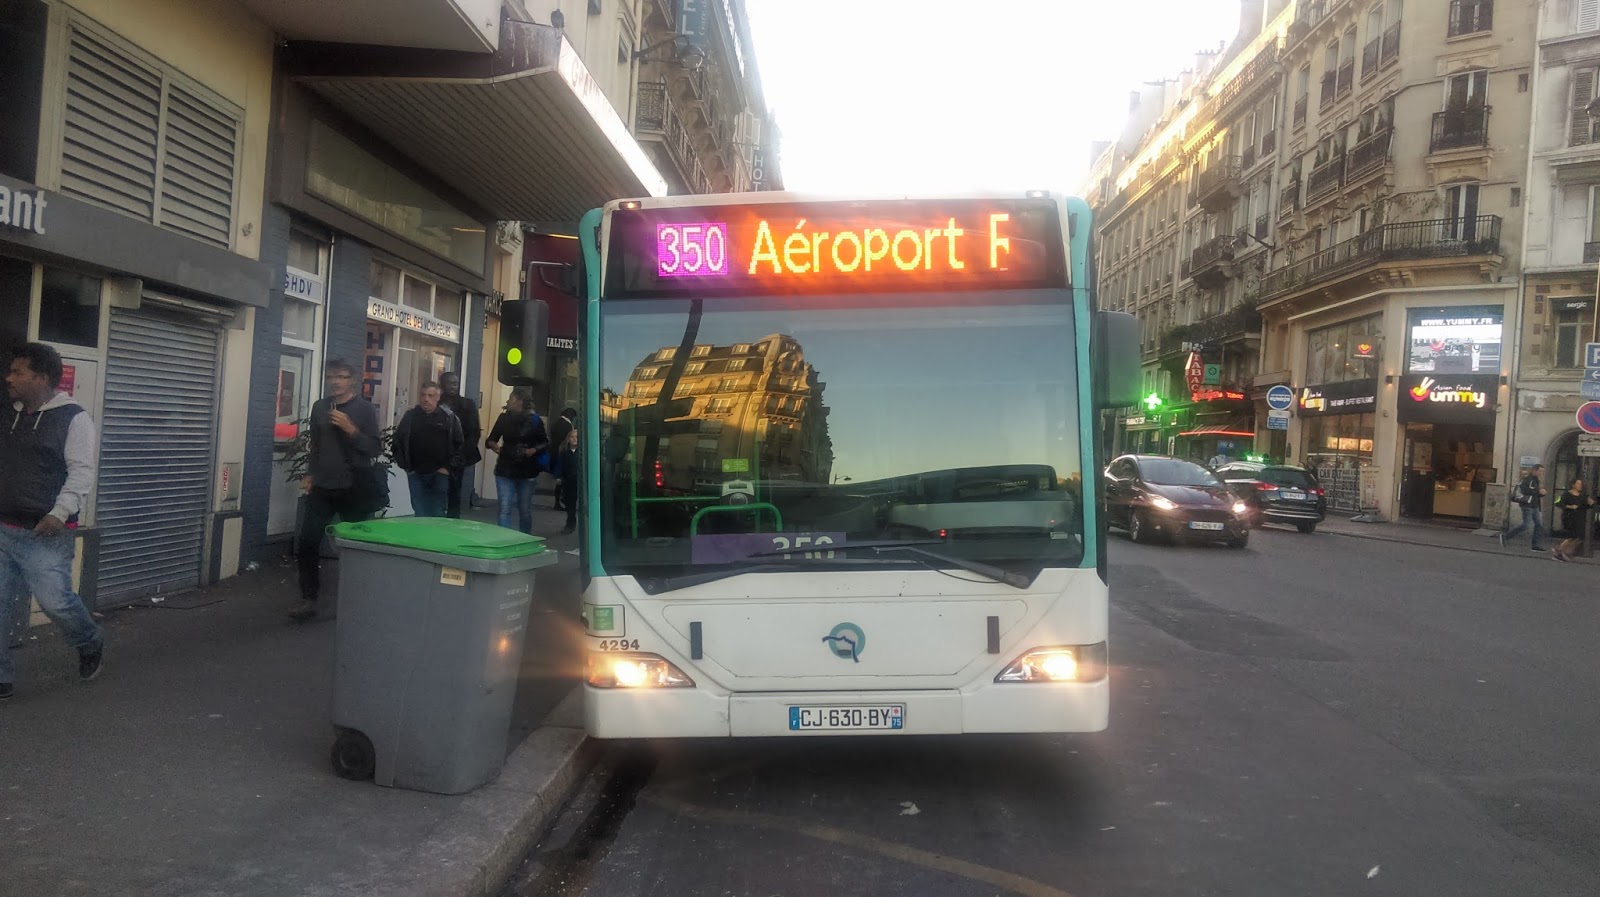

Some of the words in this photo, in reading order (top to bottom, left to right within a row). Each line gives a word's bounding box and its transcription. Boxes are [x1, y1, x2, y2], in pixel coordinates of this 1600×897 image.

[660, 226, 725, 274] 350
[749, 219, 965, 275] Aéroport
[372, 303, 394, 320] GRAND
[395, 310, 412, 326] HOTEL
[413, 316, 424, 329] DES
[424, 319, 452, 337] VOYAGEURS
[1421, 318, 1493, 326] WWW.YUMMY.FR
[1191, 354, 1202, 391] TABAC
[600, 639, 640, 651] 4294
[892, 718, 902, 726] 75
